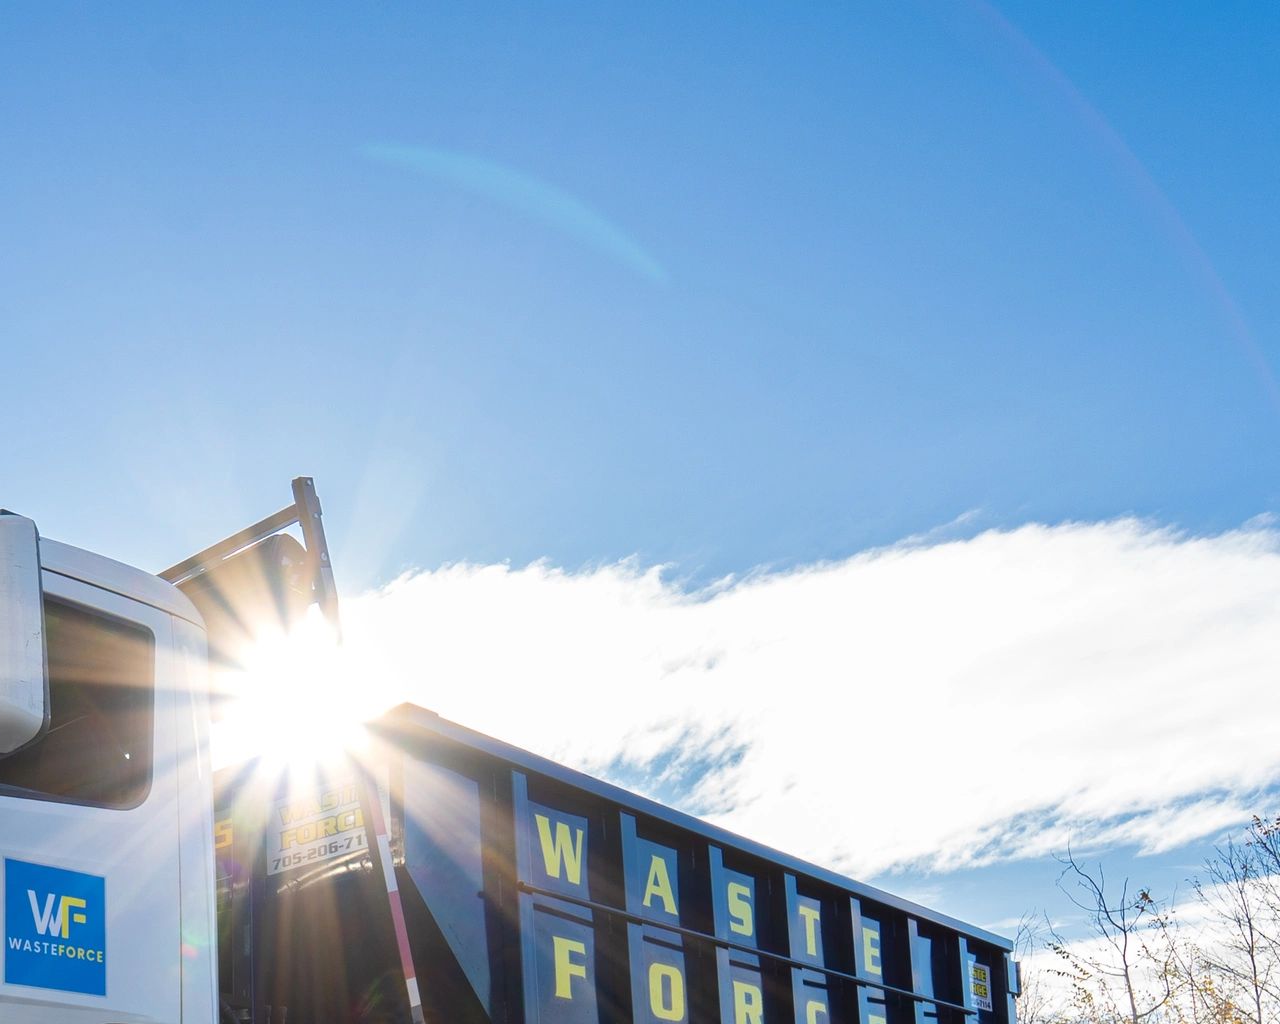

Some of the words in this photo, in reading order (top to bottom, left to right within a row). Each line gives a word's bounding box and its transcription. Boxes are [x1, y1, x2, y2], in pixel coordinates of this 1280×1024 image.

[273, 836, 364, 871] 705-206-71
[27, 889, 86, 939] WF
[535, 814, 882, 975] WASTE
[8, 936, 104, 963] WASTEFORCE
